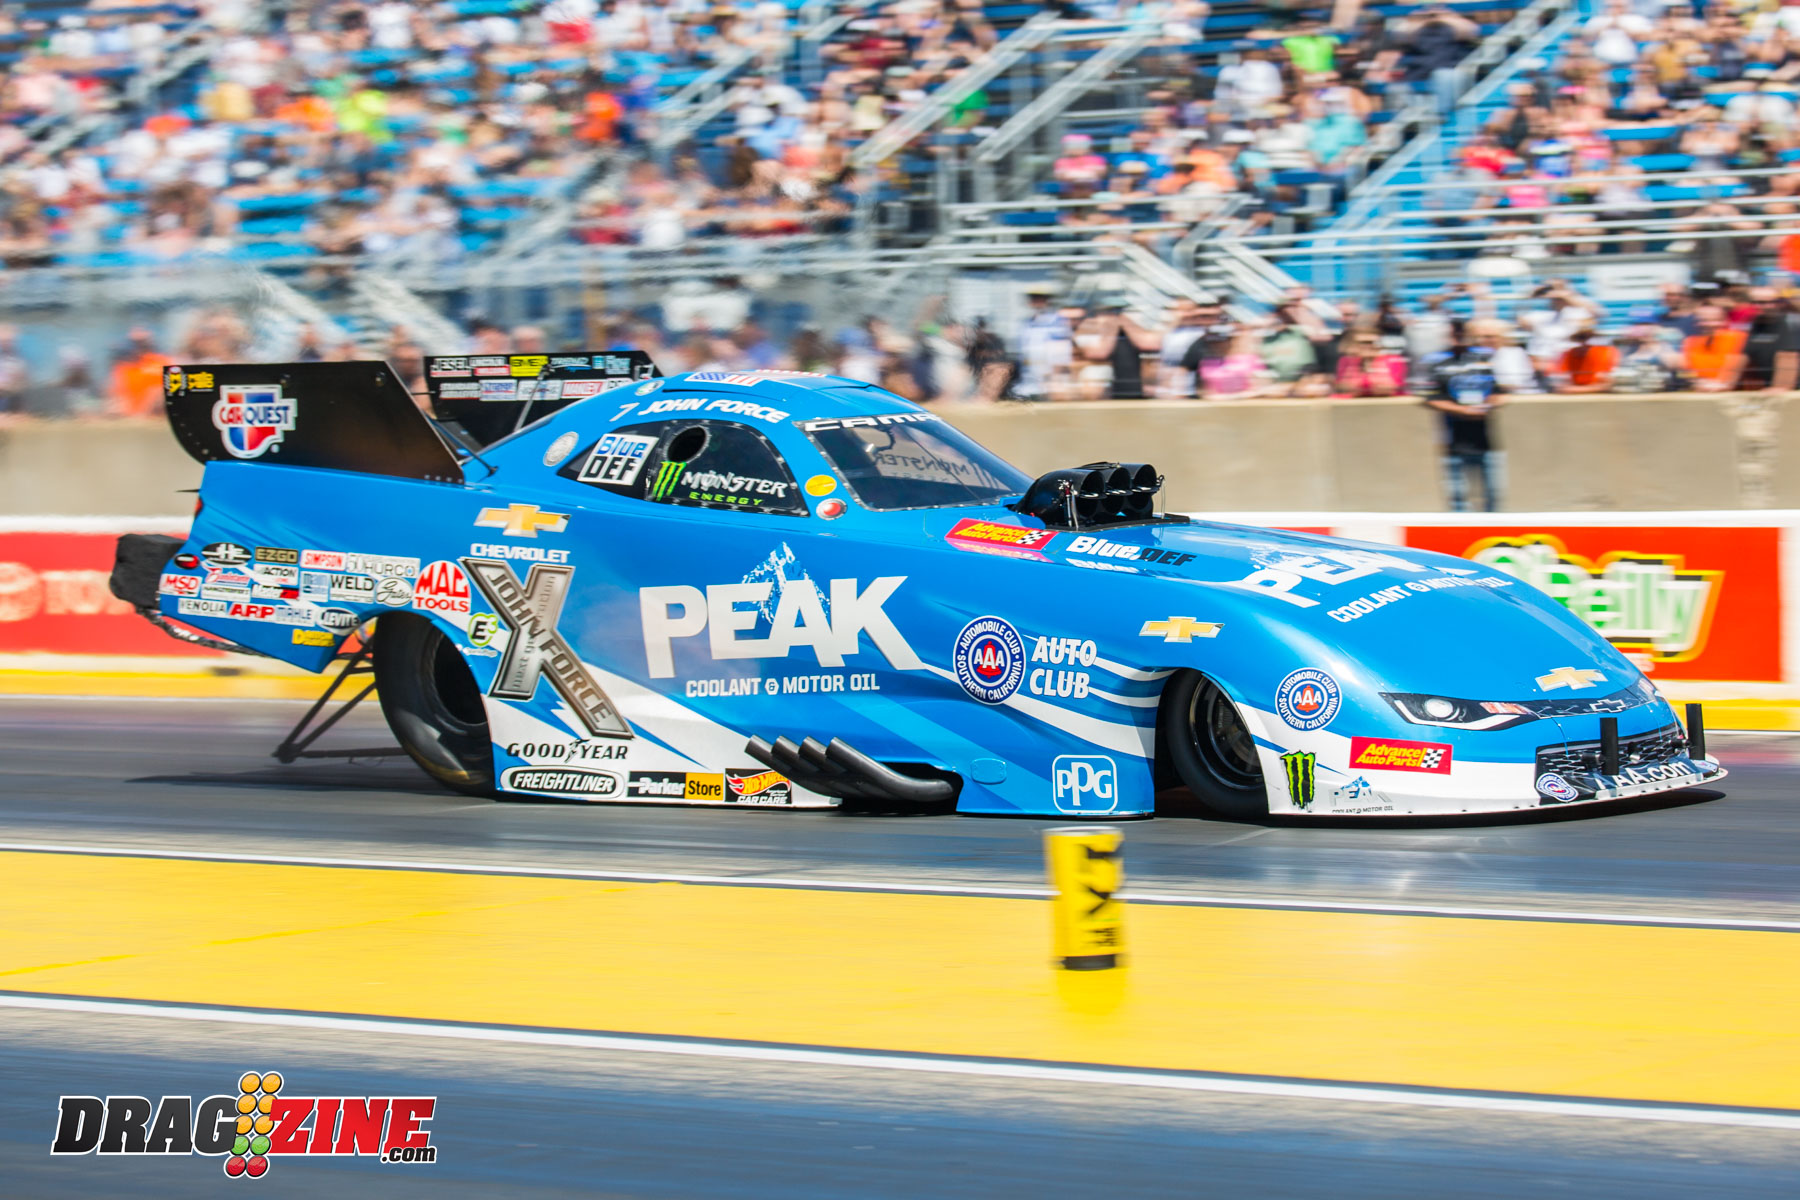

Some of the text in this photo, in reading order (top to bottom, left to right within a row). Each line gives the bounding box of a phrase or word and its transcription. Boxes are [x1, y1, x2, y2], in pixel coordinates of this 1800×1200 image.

[637, 398, 702, 417] JOHN
[704, 398, 791, 423] FORCE
[596, 436, 650, 458] Blue
[582, 456, 646, 481] DEF
[681, 469, 788, 498] MONSTER
[688, 491, 763, 506] ENERGY
[256, 548, 298, 563] EZGO
[304, 552, 343, 568] SIMPSON
[470, 543, 571, 563] CHEVROLET
[1065, 535, 1141, 560] Blue
[1138, 547, 1198, 567] DEF
[163, 575, 200, 591] MSD
[330, 575, 375, 591] WELD
[415, 562, 470, 598] MAC
[229, 603, 276, 619] ARP
[415, 597, 469, 612] TOOLS
[1326, 585, 1413, 623] COOLANT
[639, 575, 927, 679] PEAK
[960, 620, 1022, 656] AUTOMOBILE CLUB
[486, 573, 613, 723] JOHN FORCE
[973, 647, 1006, 670] AAA
[1030, 635, 1098, 668] AUTO
[685, 677, 762, 698] COOLANT
[782, 673, 845, 694] MOTOR
[850, 673, 880, 692] OIL
[956, 654, 1023, 701] SOUTHERN CALIFORNIA
[1029, 668, 1091, 699] CLUB
[1281, 671, 1338, 695] AUTOMOBILE CLUB
[1293, 689, 1323, 707] AAA
[1278, 696, 1339, 730] SOUTHERN CALIFORNIA
[1355, 754, 1419, 768] Auto Parts
[1362, 743, 1422, 758] Advance
[512, 771, 616, 794] FREIGHTLINER
[1594, 761, 1692, 790] AAA.com
[687, 779, 722, 797] Store
